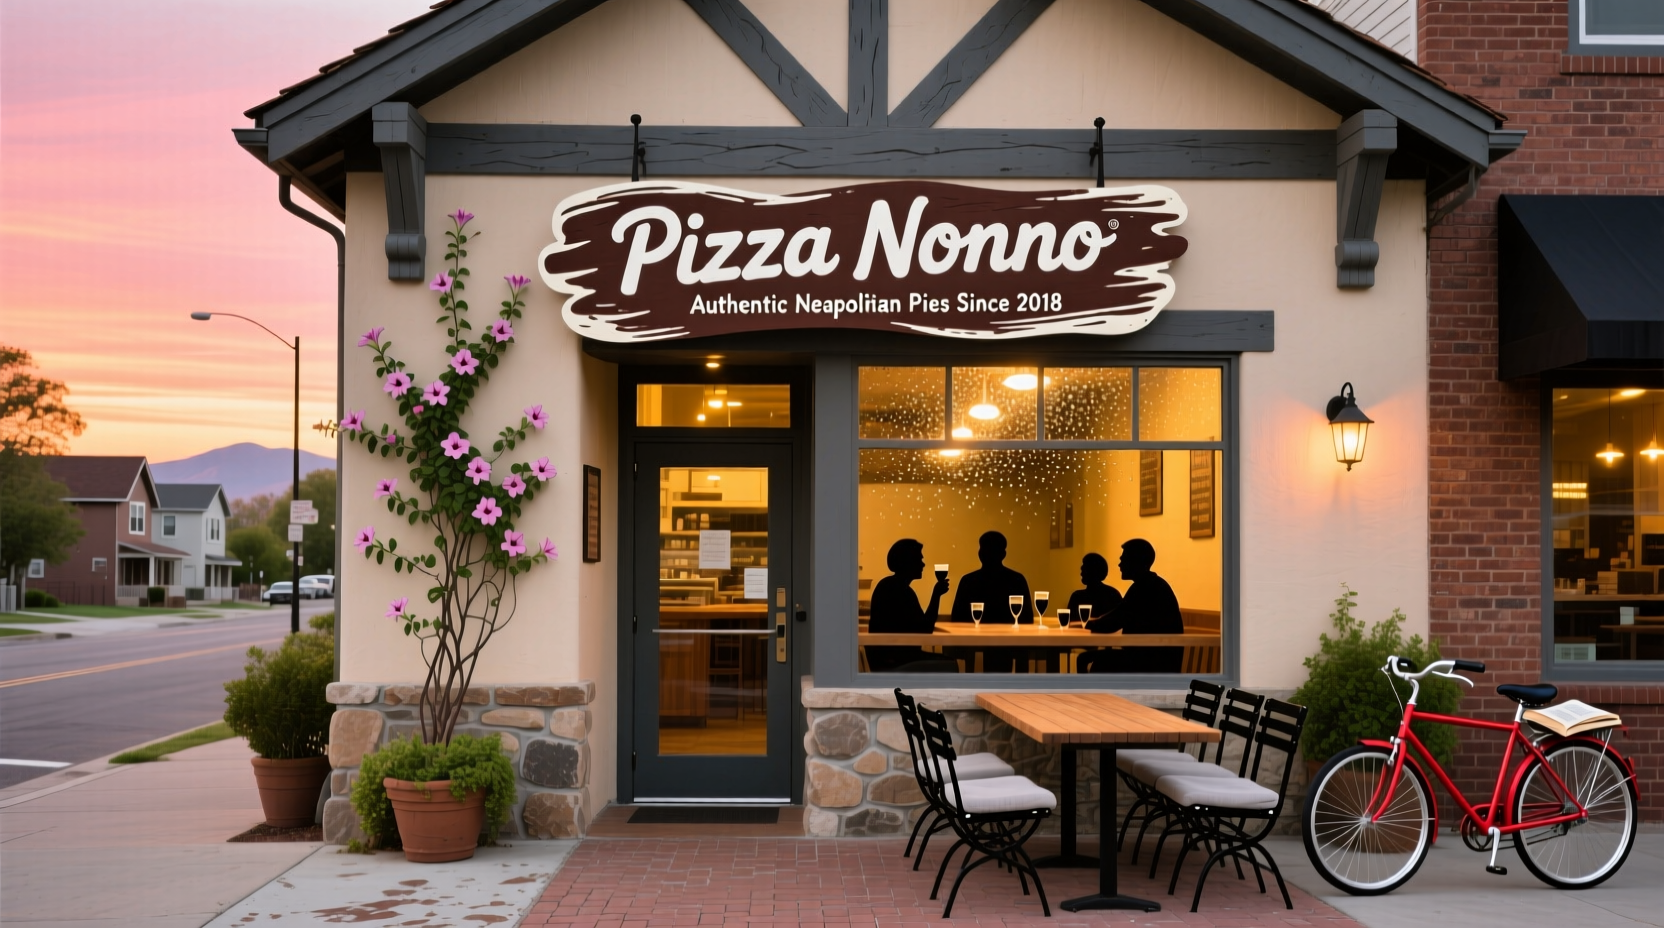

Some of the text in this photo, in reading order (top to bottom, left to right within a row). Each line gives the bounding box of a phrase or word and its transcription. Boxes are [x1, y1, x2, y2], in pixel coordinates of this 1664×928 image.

[611, 205, 841, 296] Pizza
[689, 294, 788, 316] Authentic
[909, 292, 950, 314] Pies
[956, 292, 1010, 314] Since
[1016, 292, 1063, 313] 2018
